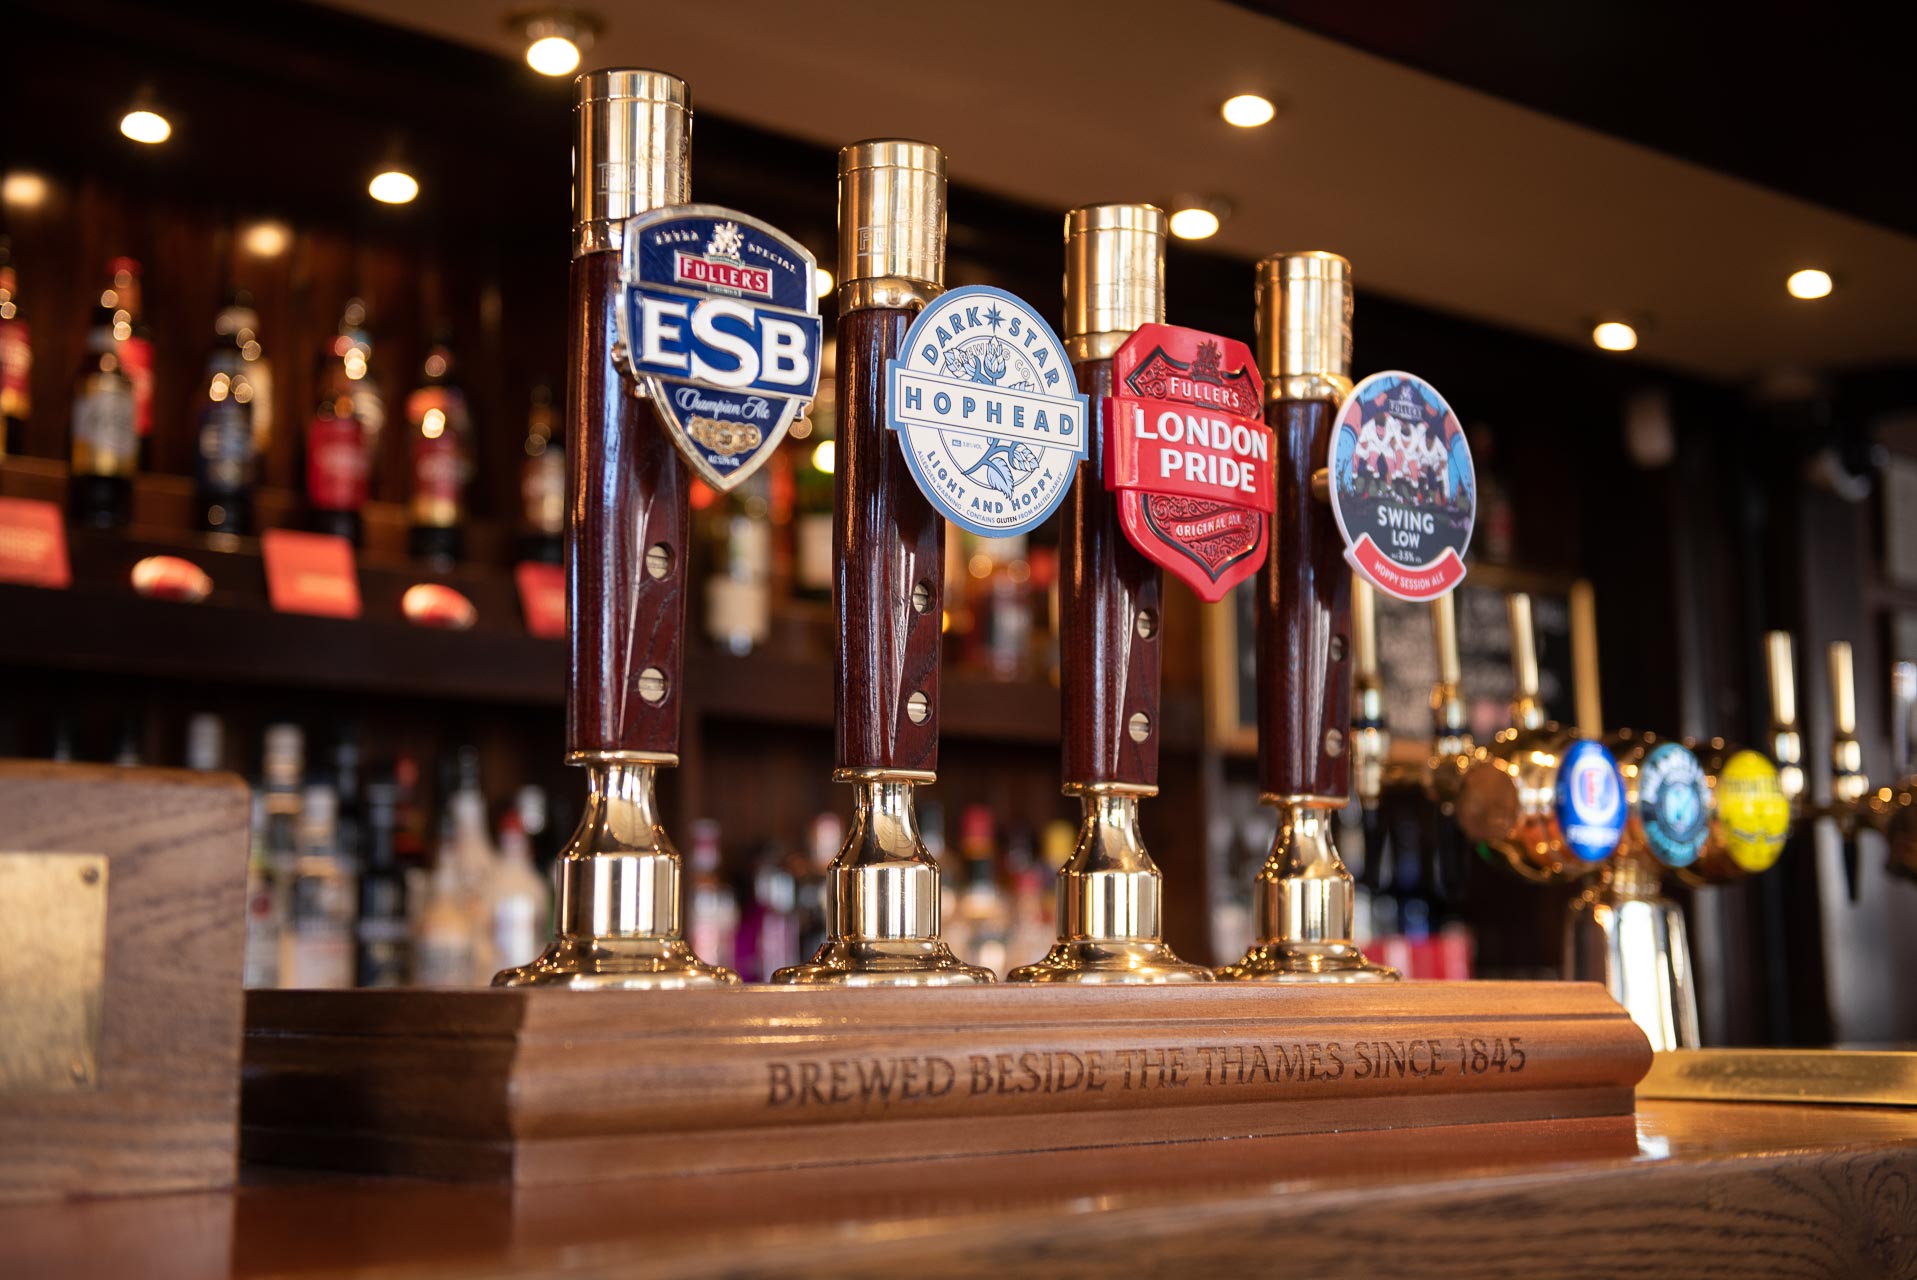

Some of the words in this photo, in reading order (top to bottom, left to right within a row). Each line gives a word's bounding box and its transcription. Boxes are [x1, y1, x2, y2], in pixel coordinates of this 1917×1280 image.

[682, 257, 765, 290] FULLER'S
[640, 297, 810, 388] ESB
[921, 306, 983, 366] DARK
[1008, 317, 1060, 388] STAR
[675, 387, 741, 420] Champion
[741, 396, 770, 419] Ale
[905, 386, 1074, 436] HOPHEAD
[1170, 376, 1240, 409] FULLER'S
[1135, 408, 1268, 462] LONDON
[917, 450, 936, 484] ALLERGEN
[936, 482, 962, 510] WARNING
[966, 509, 996, 524] CONTAINS
[996, 515, 1018, 524] GLUTEN
[1018, 509, 1034, 520] FROM
[1033, 493, 1051, 512] MALTED
[1049, 471, 1063, 494] BARLEY
[927, 450, 966, 499] LIGHT
[971, 497, 1004, 514] AND
[1011, 467, 1053, 511] HOPPY
[1160, 447, 1257, 493] PRIDE
[1175, 517, 1226, 537] ORIGINAL
[1377, 505, 1435, 535] SWING
[1392, 529, 1420, 549] LOW
[1375, 560, 1400, 585] HOPPY
[1400, 576, 1430, 591] SESSION
[1432, 570, 1445, 587] ALE
[767, 1056, 955, 1107] BREWED
[968, 1049, 1107, 1096] BESIDE
[1115, 1048, 1190, 1091] THE
[1196, 1041, 1345, 1087] THAMES
[1354, 1038, 1447, 1081] SINCE
[1458, 1036, 1527, 1076] 1845
